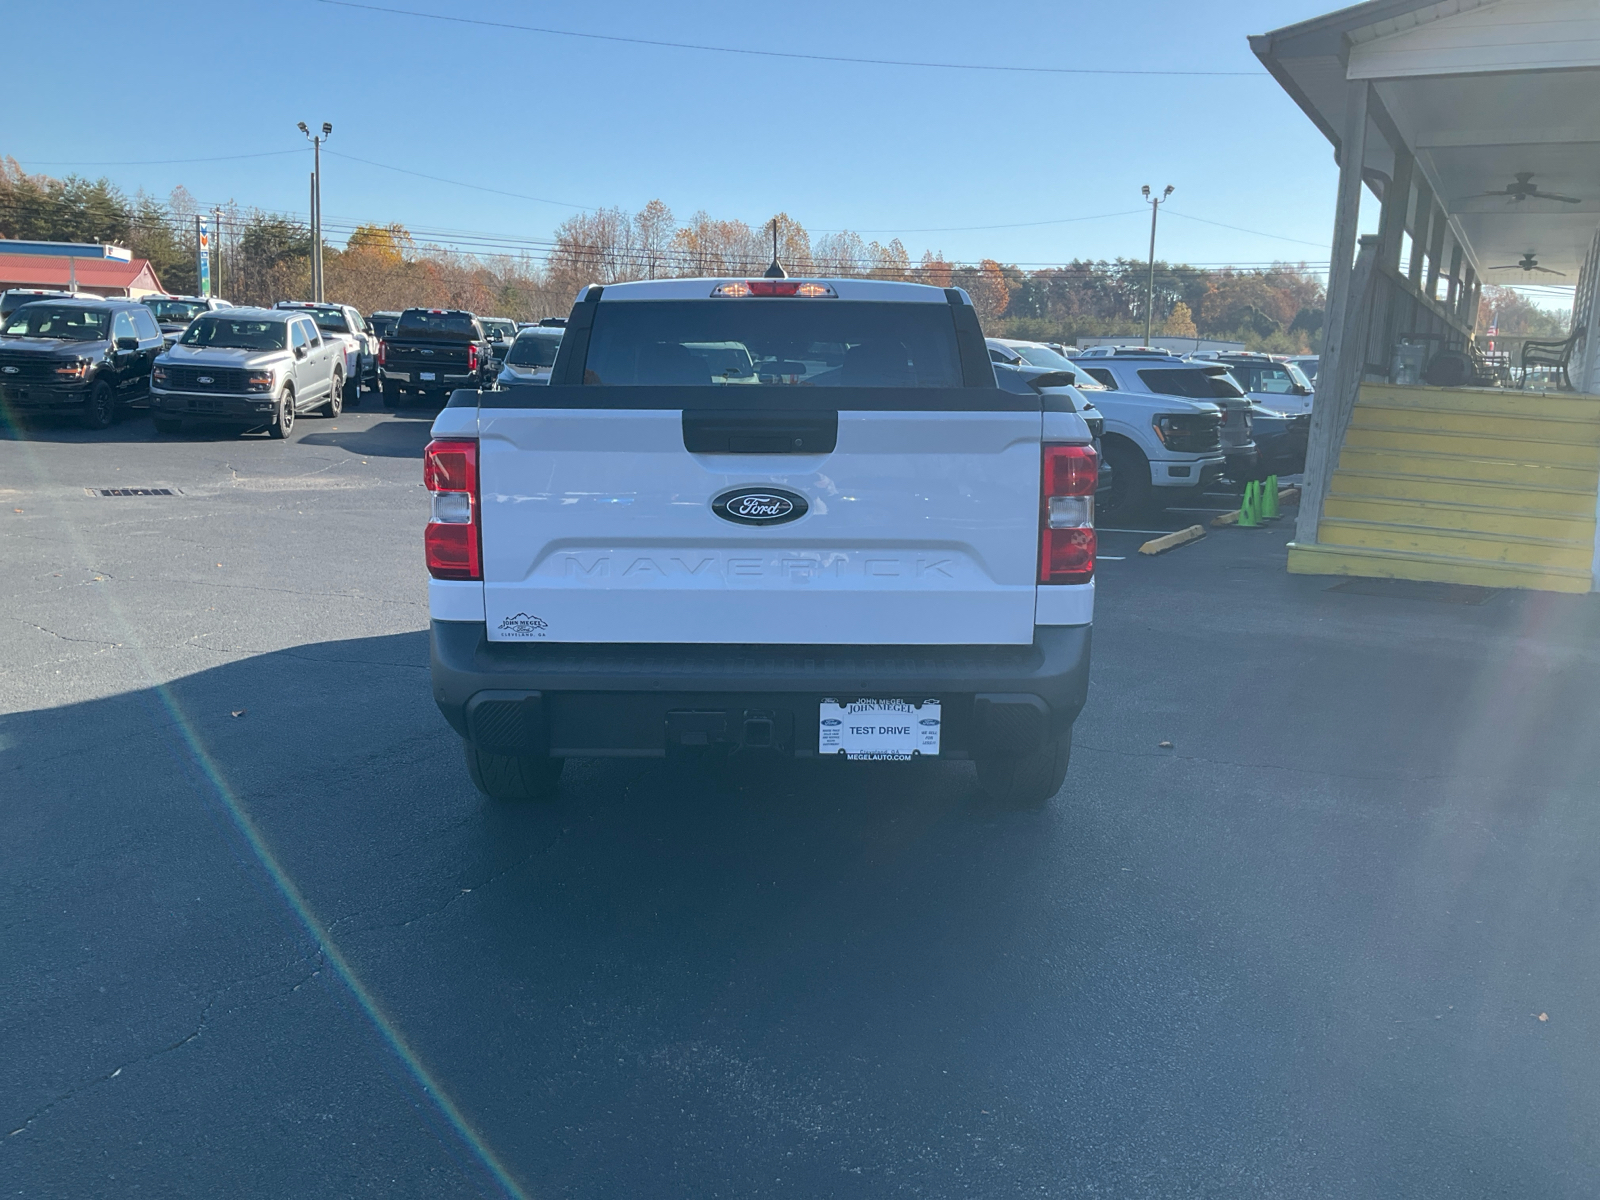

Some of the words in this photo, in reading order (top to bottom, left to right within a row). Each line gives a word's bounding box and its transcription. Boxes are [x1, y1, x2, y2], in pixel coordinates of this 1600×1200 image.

[739, 496, 780, 516] Ford
[565, 557, 954, 579] MAVERICK
[847, 704, 875, 715] JOHN
[877, 704, 914, 714] MEGEL
[849, 726, 876, 735] TEST
[878, 726, 911, 735] DRIVE
